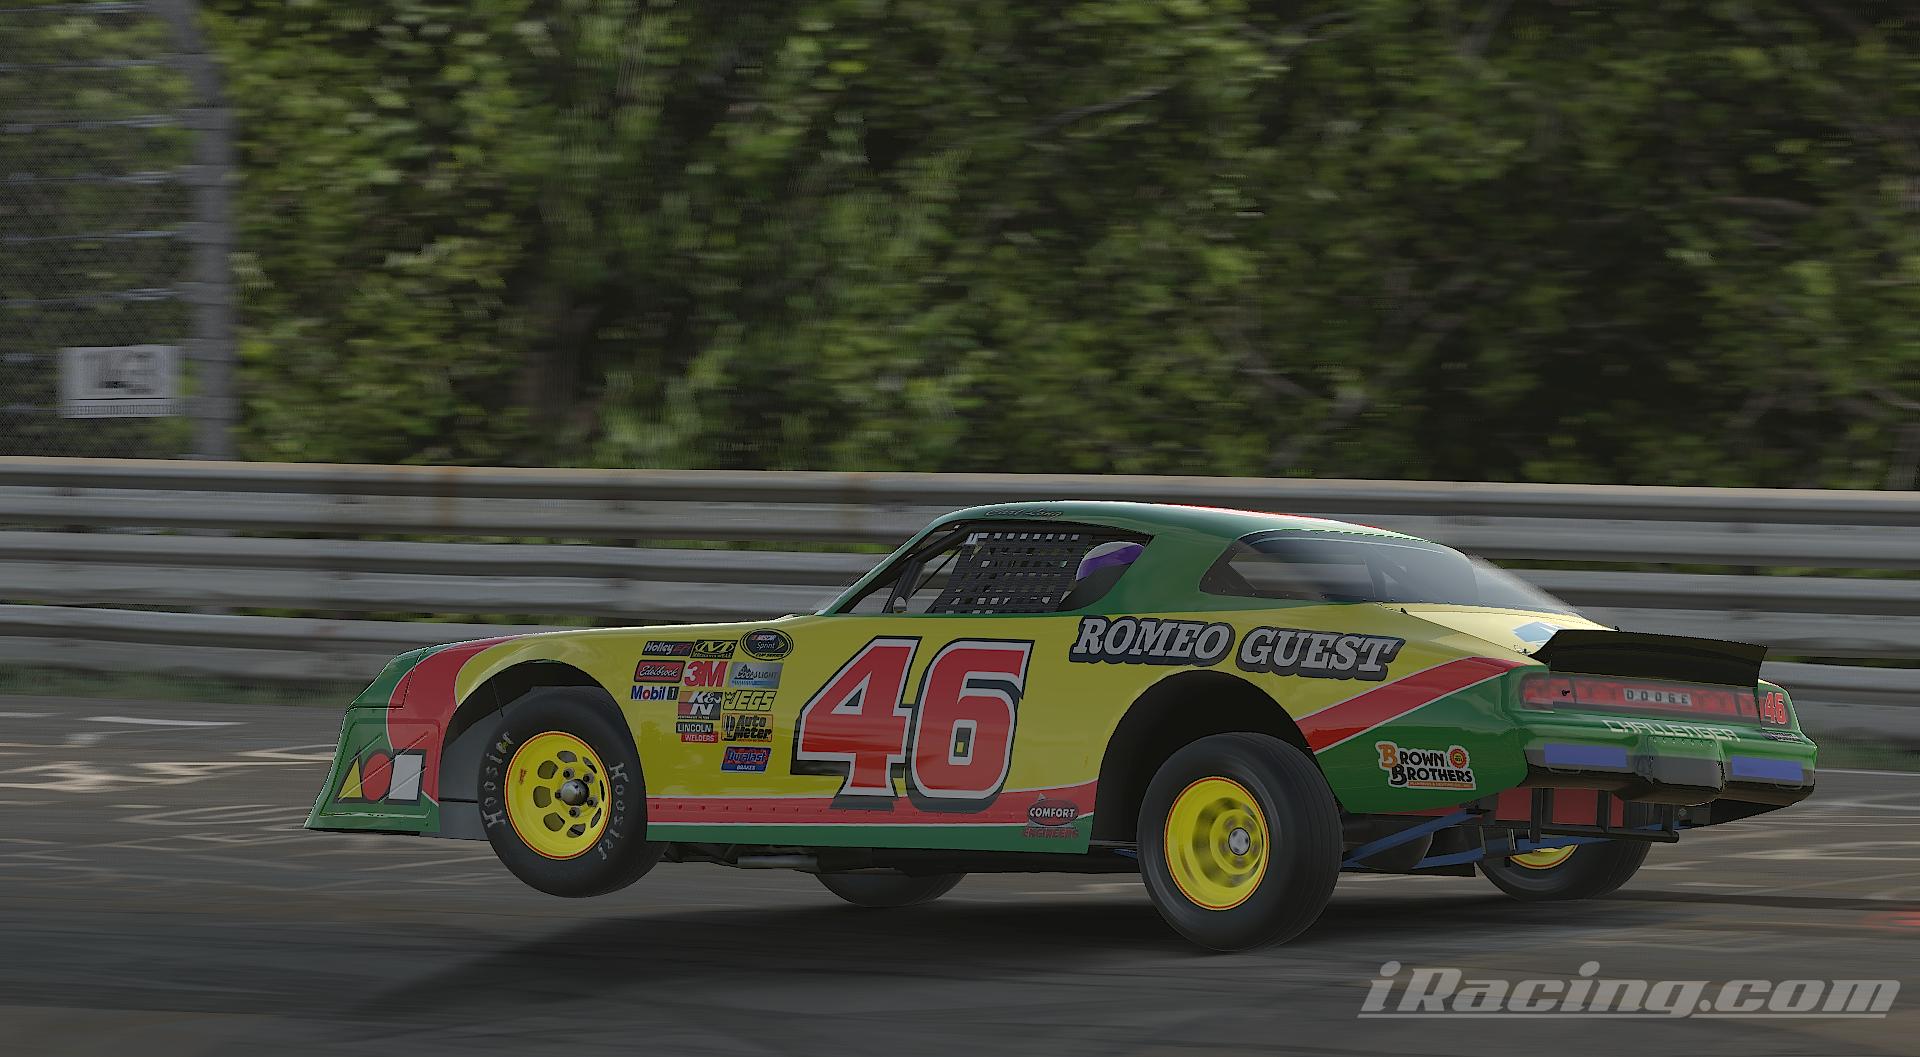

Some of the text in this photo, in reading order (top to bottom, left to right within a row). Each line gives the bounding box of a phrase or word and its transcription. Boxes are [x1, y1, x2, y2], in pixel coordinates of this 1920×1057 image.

[644, 641, 674, 655] Holley
[1073, 617, 1398, 673] ROMEO GUEST
[639, 666, 679, 678] Edelbrock
[684, 660, 729, 688] 3M
[630, 685, 666, 700] Mobil
[722, 689, 778, 711] JEGS
[1626, 689, 1690, 705] DODGE
[796, 635, 1034, 800] 46
[1764, 691, 1787, 725] 46
[677, 723, 712, 733] LINCOLN
[684, 734, 715, 742] WELDERS
[1601, 719, 1742, 743] CHALLENGER
[1377, 743, 1445, 768] BROWN
[481, 730, 515, 829] Hoosier
[1390, 764, 1473, 785] BROTHERS
[597, 761, 630, 861] Hoosier
[1029, 807, 1075, 818] COMFORT
